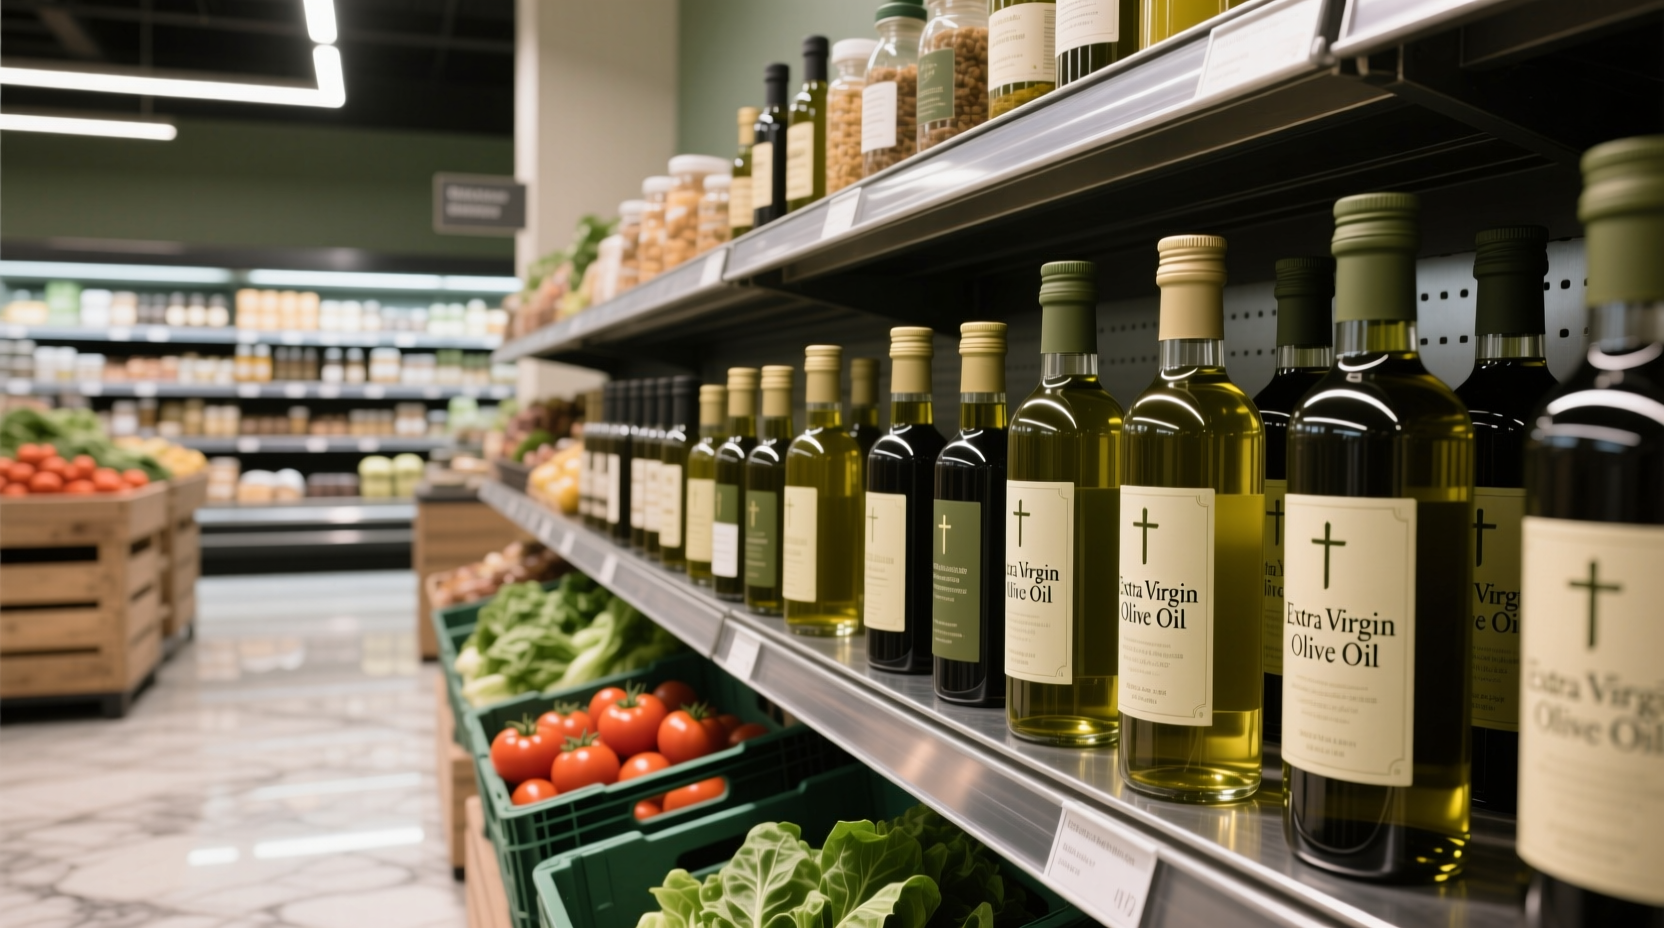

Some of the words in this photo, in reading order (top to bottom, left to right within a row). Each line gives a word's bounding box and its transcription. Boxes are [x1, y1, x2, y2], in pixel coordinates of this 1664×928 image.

[1029, 585, 1053, 604] Oil
[1144, 580, 1199, 608] Virgin
[1473, 582, 1521, 612] Virg
[1121, 601, 1151, 626] Olive
[1156, 607, 1187, 630] Oil
[1286, 601, 1323, 631] Extra
[1325, 608, 1397, 643] Virgin
[1491, 611, 1519, 634] Oi
[1291, 633, 1336, 664] Olive
[1342, 642, 1381, 669] Oil
